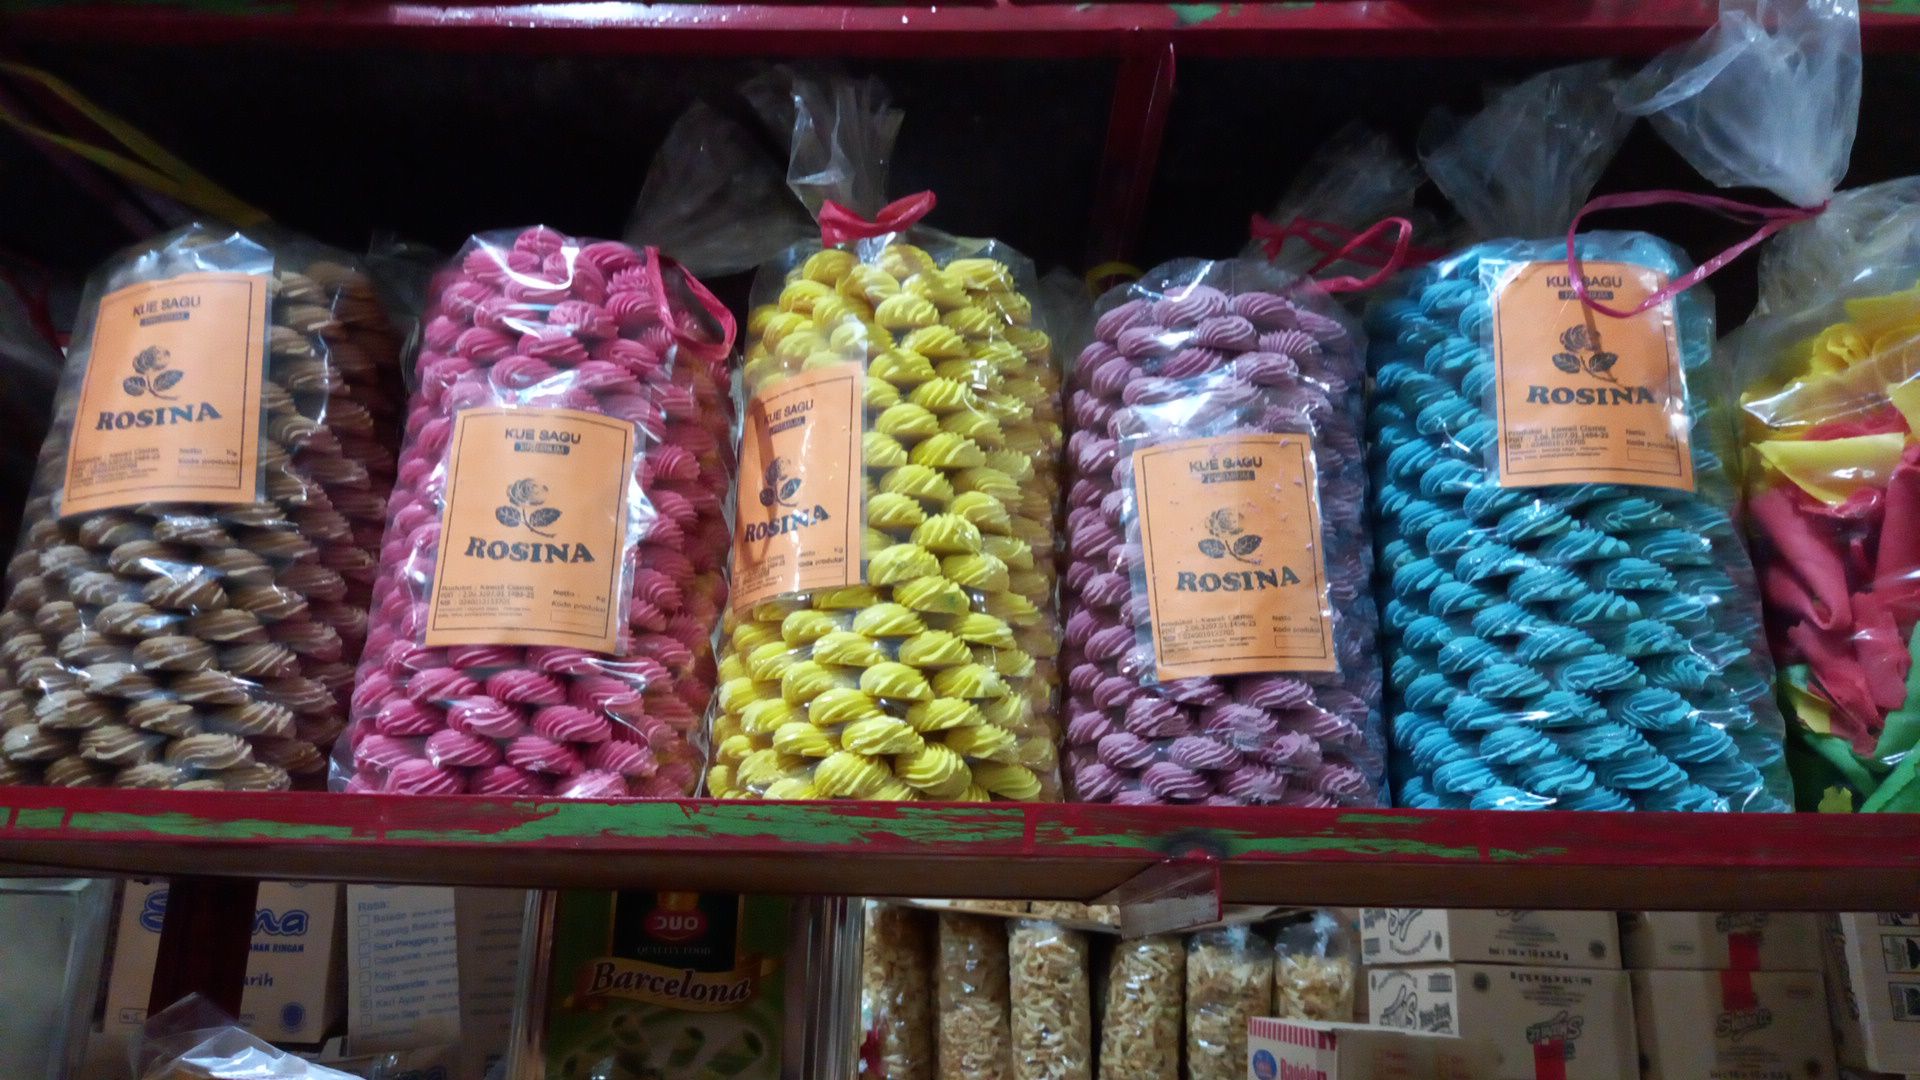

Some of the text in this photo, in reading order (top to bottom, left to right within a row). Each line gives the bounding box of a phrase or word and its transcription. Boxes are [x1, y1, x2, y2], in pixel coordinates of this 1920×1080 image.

[133, 296, 201, 317] KUE SAGU
[1526, 385, 1656, 406] ROSINA
[96, 401, 222, 431] ROSINA
[784, 399, 814, 417] SAGU
[505, 428, 582, 444] KUE SAGU
[1189, 459, 1219, 474] KUE
[744, 504, 830, 544] ROSINA
[464, 536, 595, 564] ROSINA
[1177, 566, 1300, 593] ROSINA
[586, 961, 751, 1004] Barcelona
